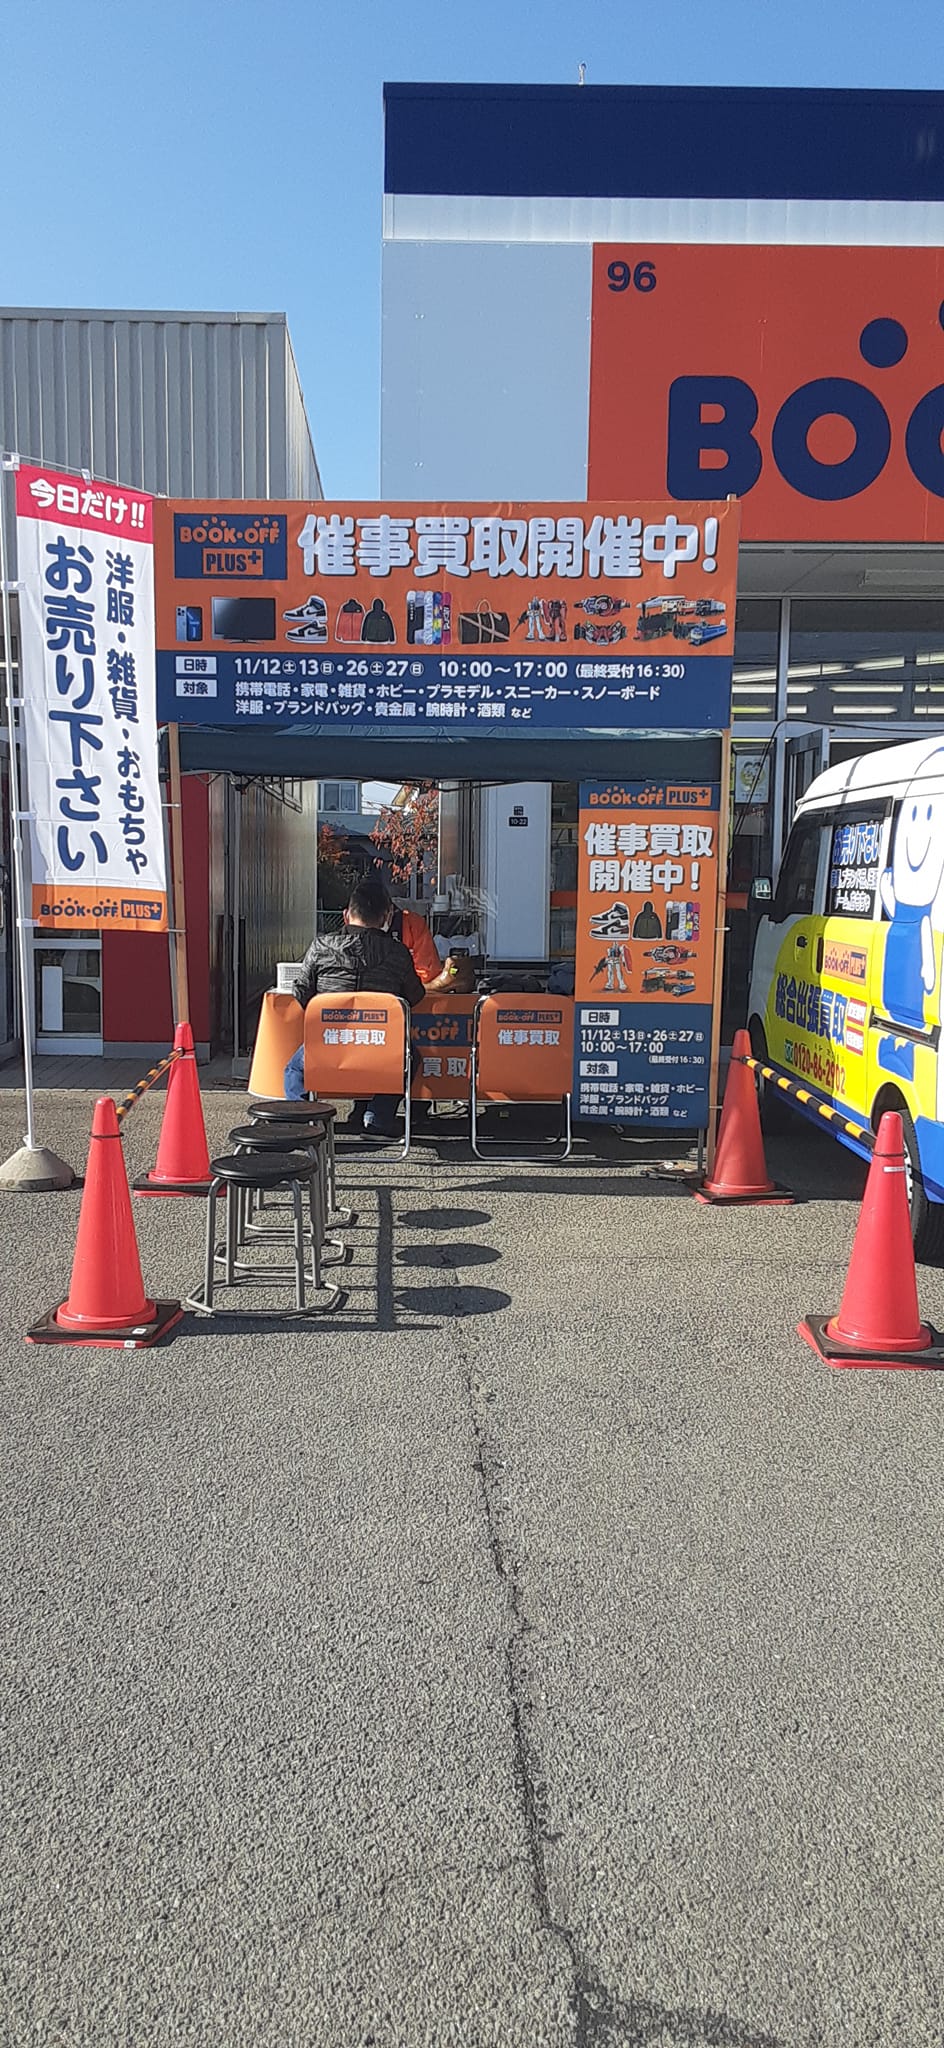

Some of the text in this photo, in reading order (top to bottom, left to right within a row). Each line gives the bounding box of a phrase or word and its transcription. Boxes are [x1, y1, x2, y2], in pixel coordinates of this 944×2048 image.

[607, 261, 657, 292] 96
[29, 477, 146, 530] 今日だけ!!
[297, 513, 719, 578] 催事買取開催中!
[184, 658, 208, 672] 日時
[182, 681, 208, 695] 対象
[44, 535, 108, 872] お売り下さい
[105, 547, 149, 875] 洋服・雑貨・おもちゃ
[511, 707, 532, 718] など
[583, 823, 714, 857] 催事買取
[588, 1011, 611, 1023] 日時
[323, 1028, 386, 1045] 催事買取
[498, 1029, 560, 1045] 催事買取
[586, 1063, 610, 1075] 対象
